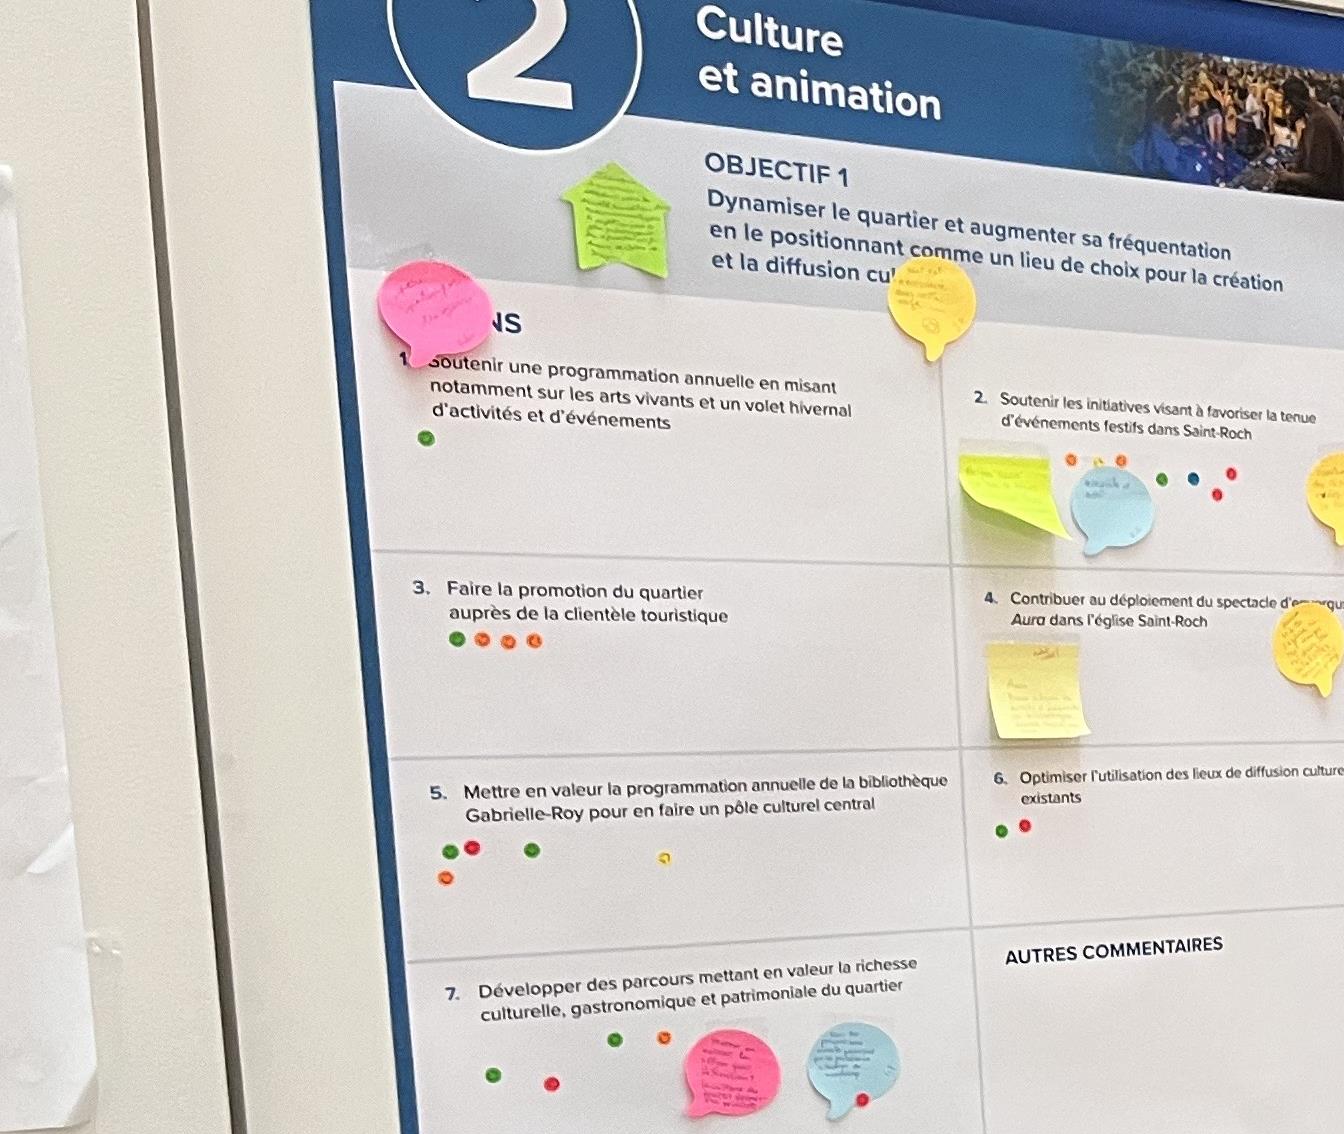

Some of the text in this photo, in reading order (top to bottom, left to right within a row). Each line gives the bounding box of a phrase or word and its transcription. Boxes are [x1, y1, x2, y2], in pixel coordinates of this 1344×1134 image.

[696, 4, 843, 56] Culture
[466, 0, 573, 110] 2
[699, 62, 941, 120] et animation
[705, 152, 848, 187] OBJECTIF 1
[708, 188, 1231, 260] Dynamiser le quartier et augmenter sa fréquentation
[710, 222, 1283, 292] en le positionnant comme un lieu de choix pour la création
[712, 253, 733, 269] et
[740, 252, 759, 272] la
[766, 256, 859, 281] diffusion
[509, 362, 542, 375] une
[548, 365, 679, 384] programmation
[684, 374, 754, 389] annuelle
[759, 379, 779, 390] en
[784, 379, 837, 394] misant
[430, 380, 851, 417] notamment sur les arts vivants et un volet hivernal
[1000, 391, 1059, 408] Soutenir
[1063, 396, 1083, 410] les
[1087, 398, 1151, 414] initiatives
[1154, 403, 1192, 416] visant
[1207, 405, 1263, 420] favoriser
[1266, 409, 1277, 421] la
[1280, 411, 1316, 424] tenue
[432, 402, 671, 430] d'activités et d'événements
[1001, 414, 1252, 440] d'événements festifs dans Saint-Roch
[447, 581, 492, 596] Faire
[498, 582, 513, 596] la
[518, 584, 607, 600] promotion
[612, 585, 633, 599] du
[639, 586, 703, 602] quartier
[1010, 591, 1277, 610] Contribuer au déploiement du spectacle
[450, 605, 728, 626] auprès de la clientèle touristique
[1010, 613, 1207, 629] Aura dans l'église Saint-Roch
[464, 785, 520, 799] Mettre
[525, 787, 547, 798] en
[551, 783, 603, 797] valeur
[608, 782, 621, 796] la
[627, 781, 747, 798] programmation
[752, 778, 816, 792] annuelle
[820, 777, 838, 790] de
[842, 776, 855, 789] la
[859, 774, 948, 789] bibliothèque
[1020, 771, 1087, 786] Optimiser
[1091, 769, 1162, 782] l'utilisation
[1166, 768, 1189, 780] des
[1193, 768, 1222, 780] lieux
[1225, 767, 1242, 779] de
[1245, 766, 1299, 778] diffusion
[466, 797, 875, 823] Gabrielle-Roy pour en faire un pôle culturel central
[1021, 792, 1081, 805] existants
[1006, 936, 1223, 965] AUTRES COMMENTAIRES
[478, 959, 917, 999] Développer des parcours mettant en valeur la richesse
[481, 979, 903, 1022] culturelle, gastronomique et patrimoniale du quartier
